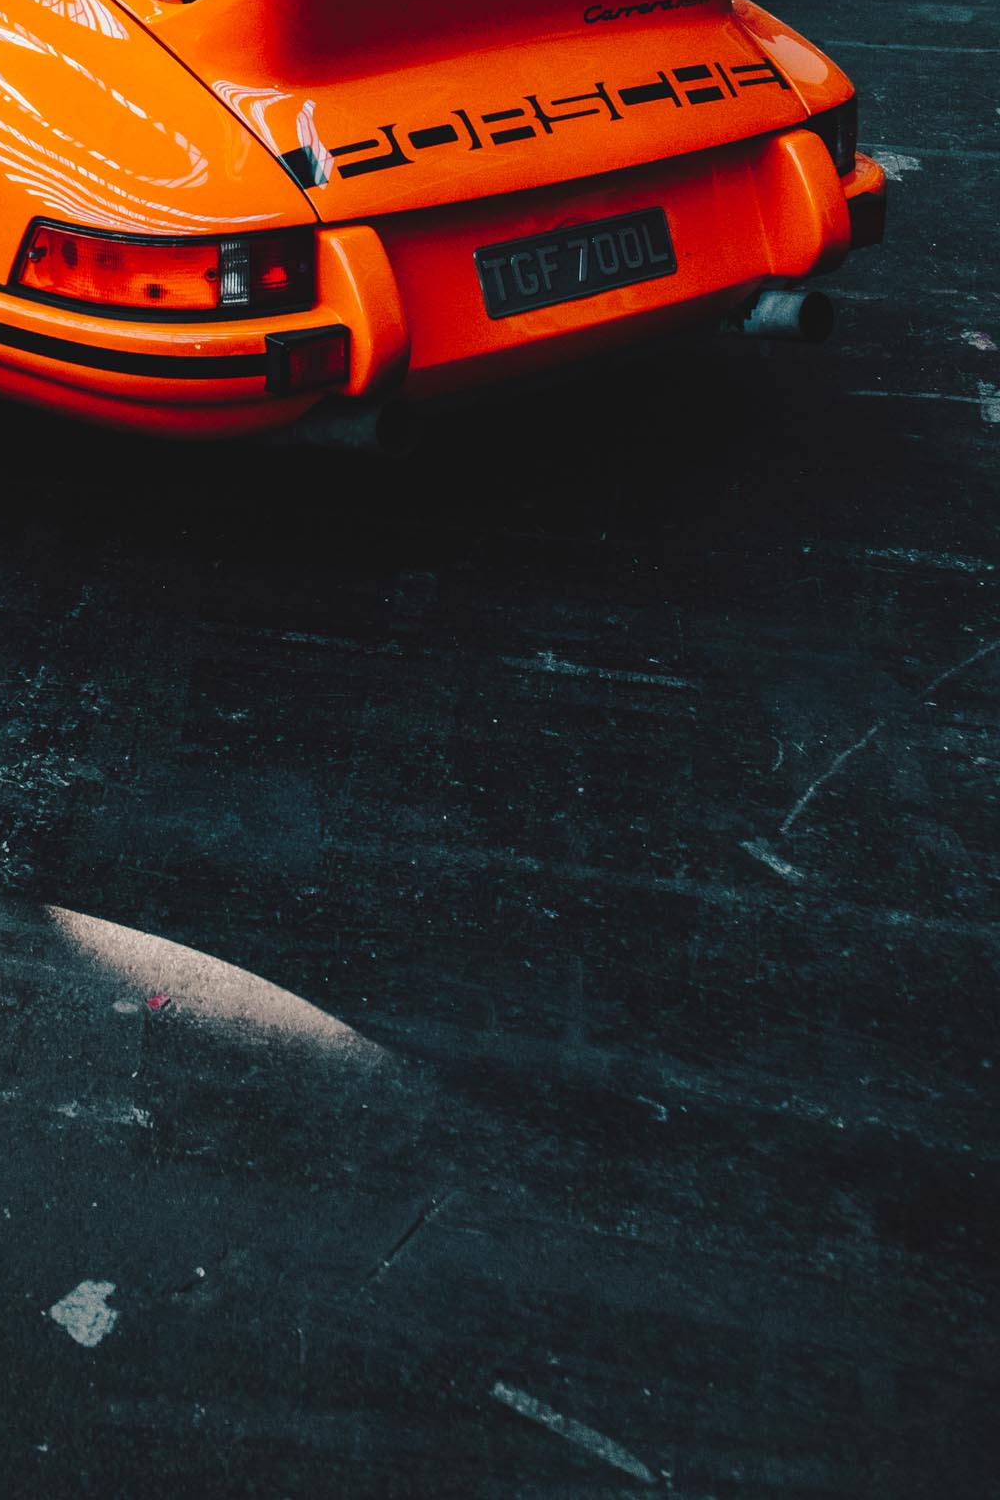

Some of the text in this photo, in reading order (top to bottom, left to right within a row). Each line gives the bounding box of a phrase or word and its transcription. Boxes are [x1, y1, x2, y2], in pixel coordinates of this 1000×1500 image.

[326, 56, 791, 180] PORSCHE
[482, 221, 669, 302] TGF 700L
